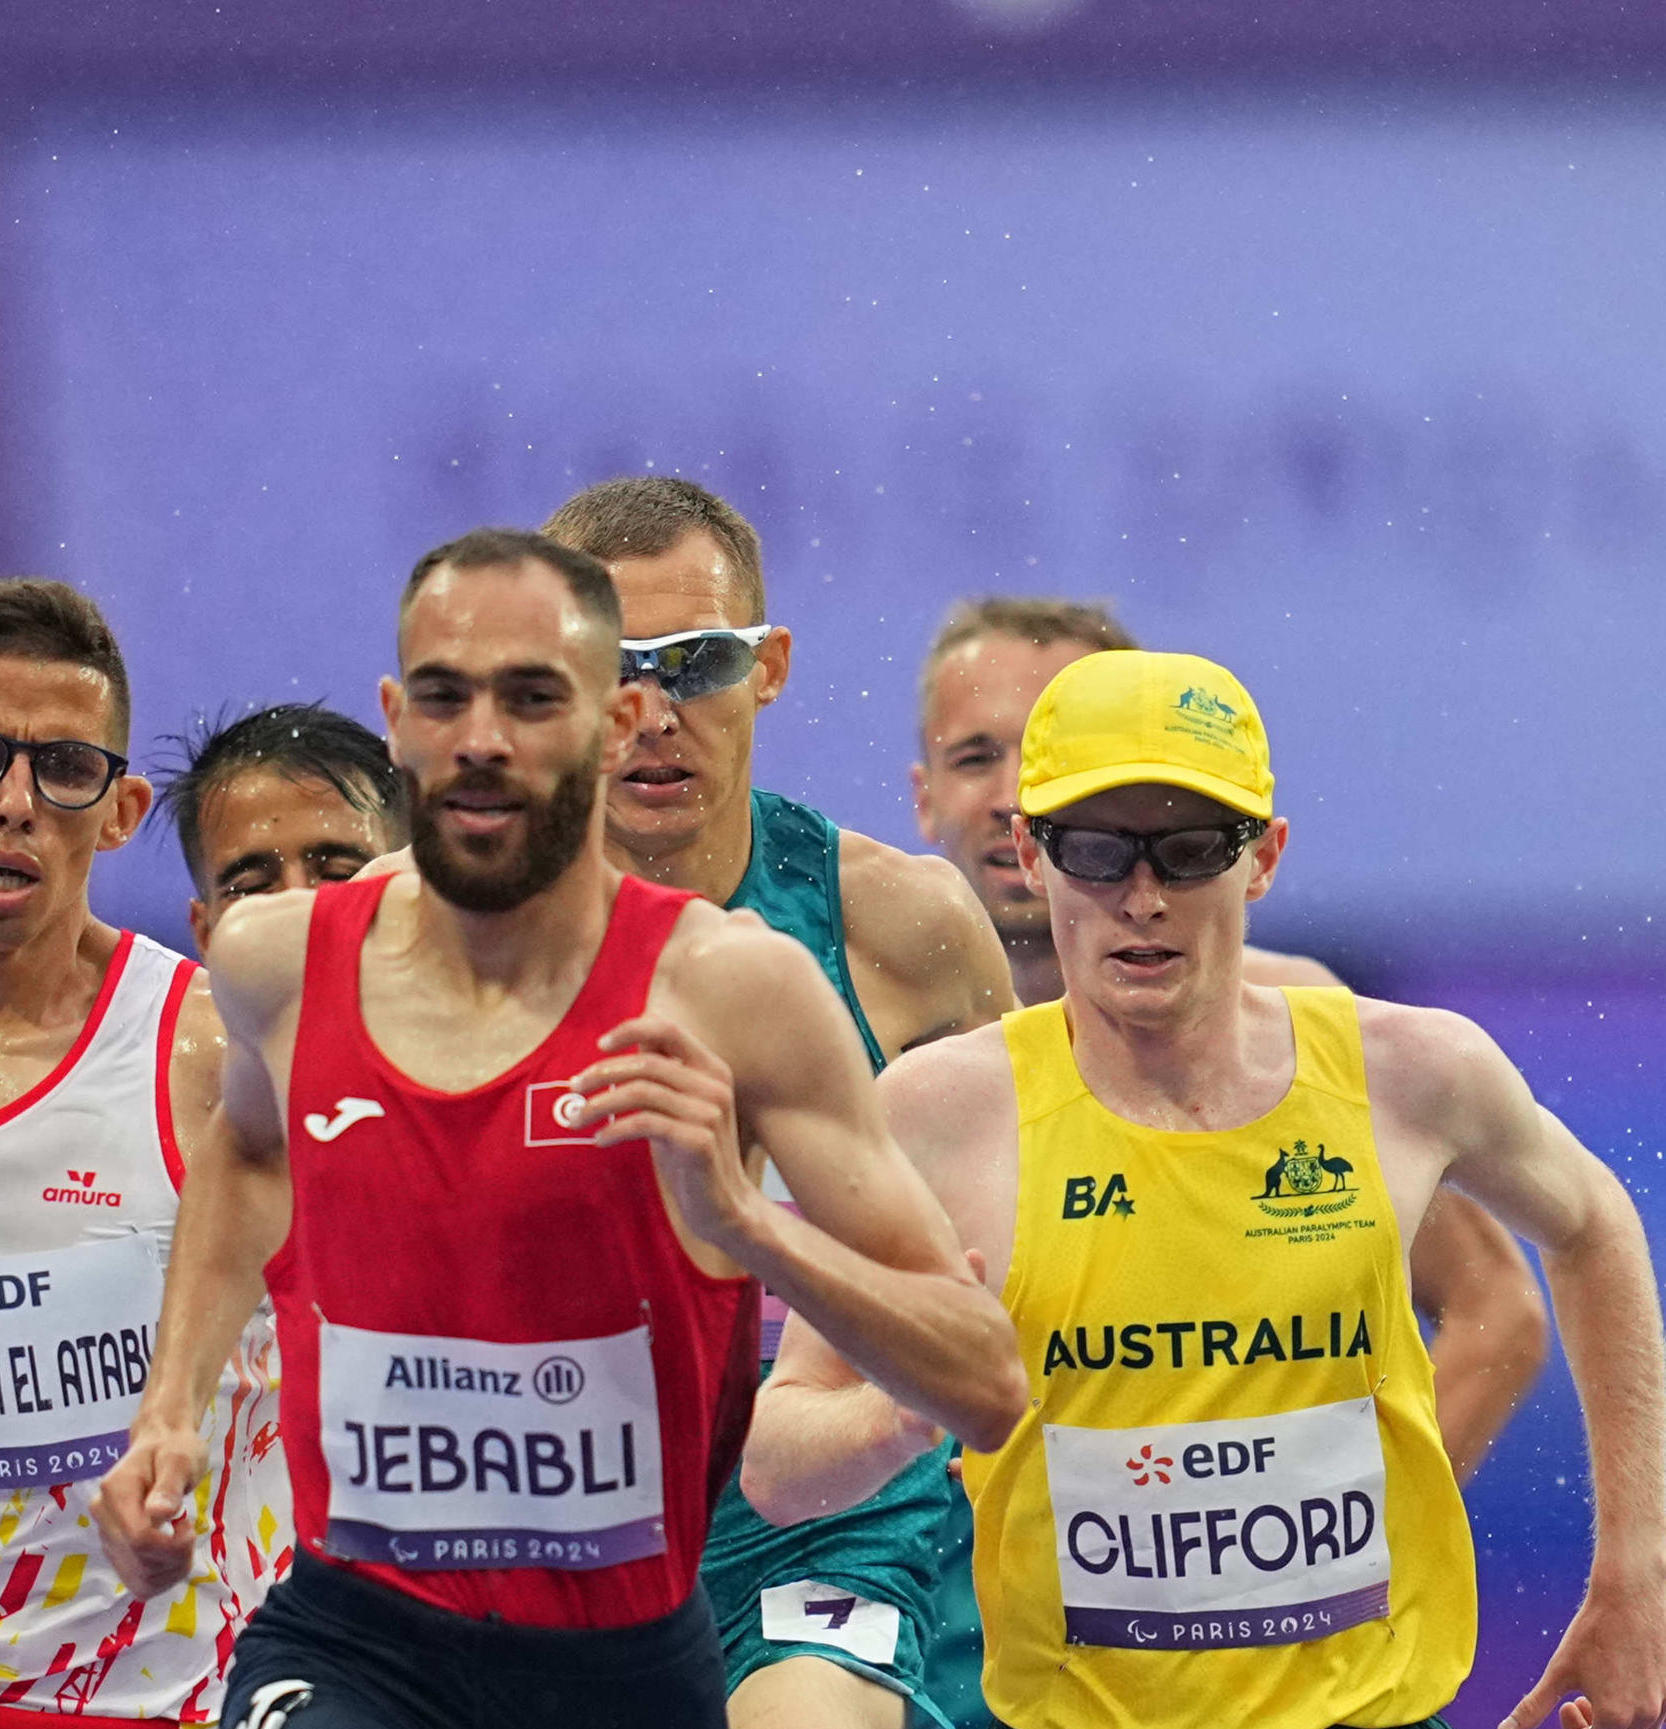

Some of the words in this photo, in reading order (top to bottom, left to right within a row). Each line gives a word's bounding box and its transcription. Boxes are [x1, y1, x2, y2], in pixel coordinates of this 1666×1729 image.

[42, 1185, 122, 1208] amura
[1245, 1226, 1298, 1237] AUSTRALIAN
[1300, 1222, 1351, 1233] PARALYMPIC
[1354, 1219, 1376, 1228] TEAM
[1288, 1234, 1313, 1244] PARIS
[1316, 1232, 1336, 1242] 2024
[1043, 1310, 1372, 1376] AUSTRALIA
[9, 1345, 53, 1414] EL
[386, 1355, 523, 1396] Allianz
[344, 1421, 635, 1496] JEBABLI
[1067, 1490, 1375, 1578] CLIFFORD
[804, 1597, 856, 1630] 7
